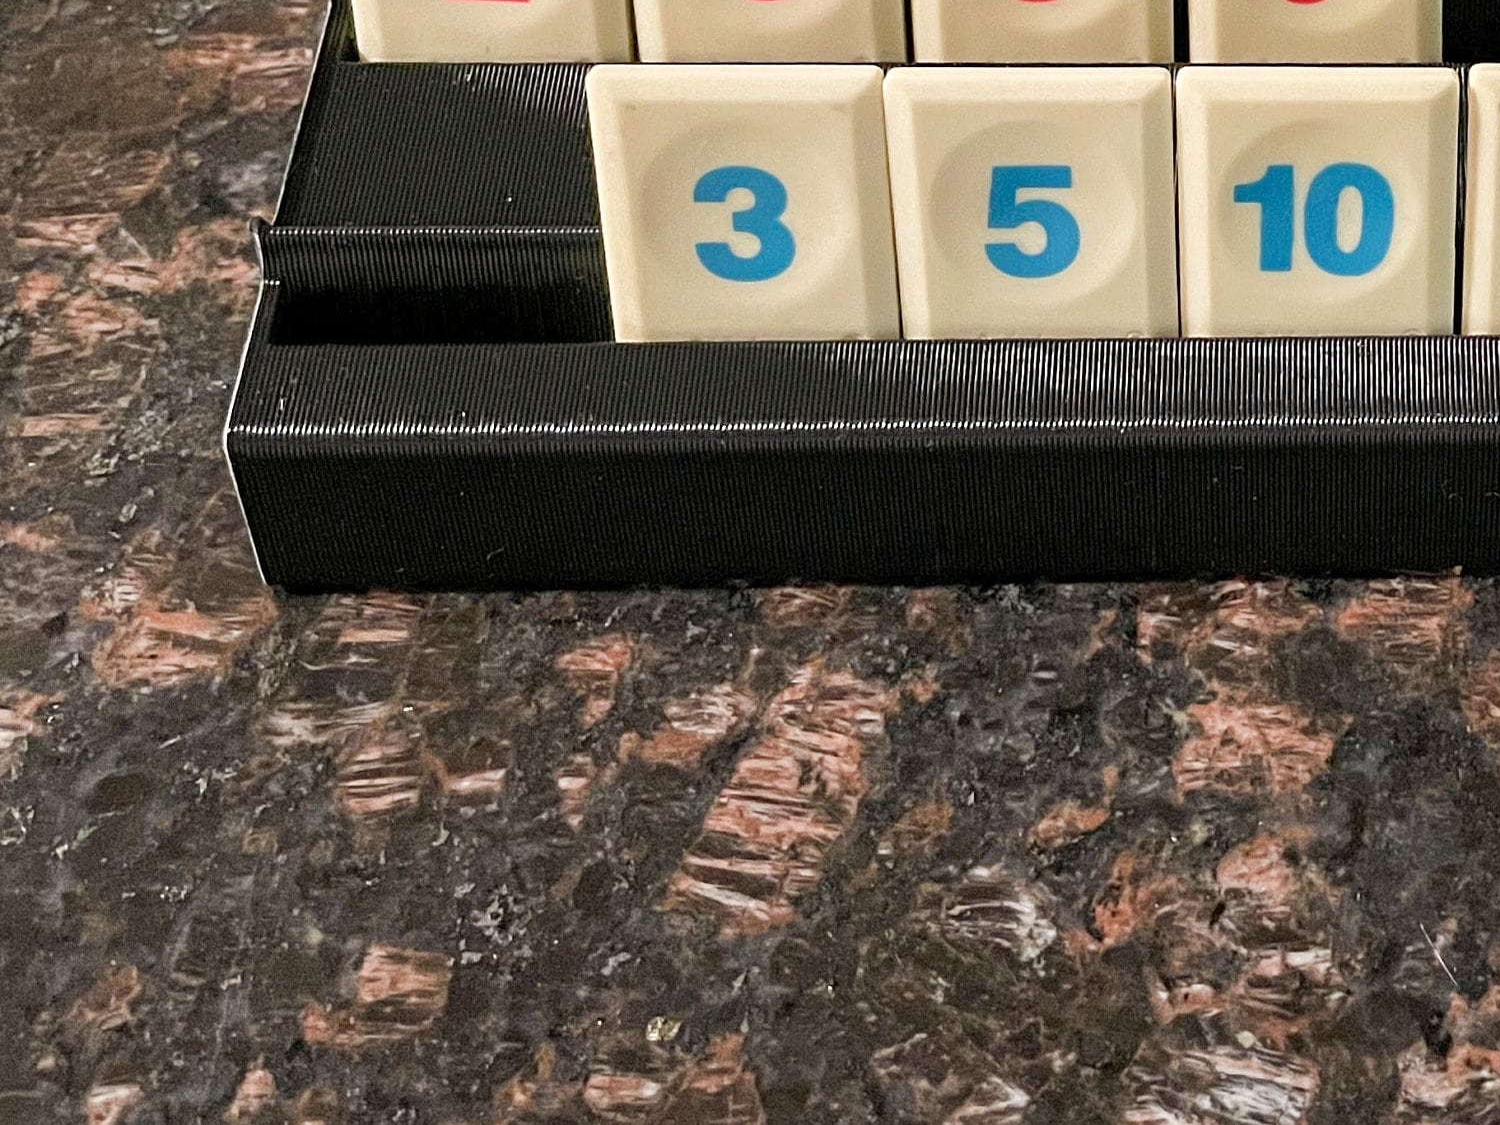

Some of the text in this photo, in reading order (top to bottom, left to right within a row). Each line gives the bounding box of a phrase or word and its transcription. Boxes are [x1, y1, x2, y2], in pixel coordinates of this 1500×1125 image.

[693, 166, 795, 282] 3
[985, 165, 1080, 278] 5
[1233, 163, 1394, 276] 10
